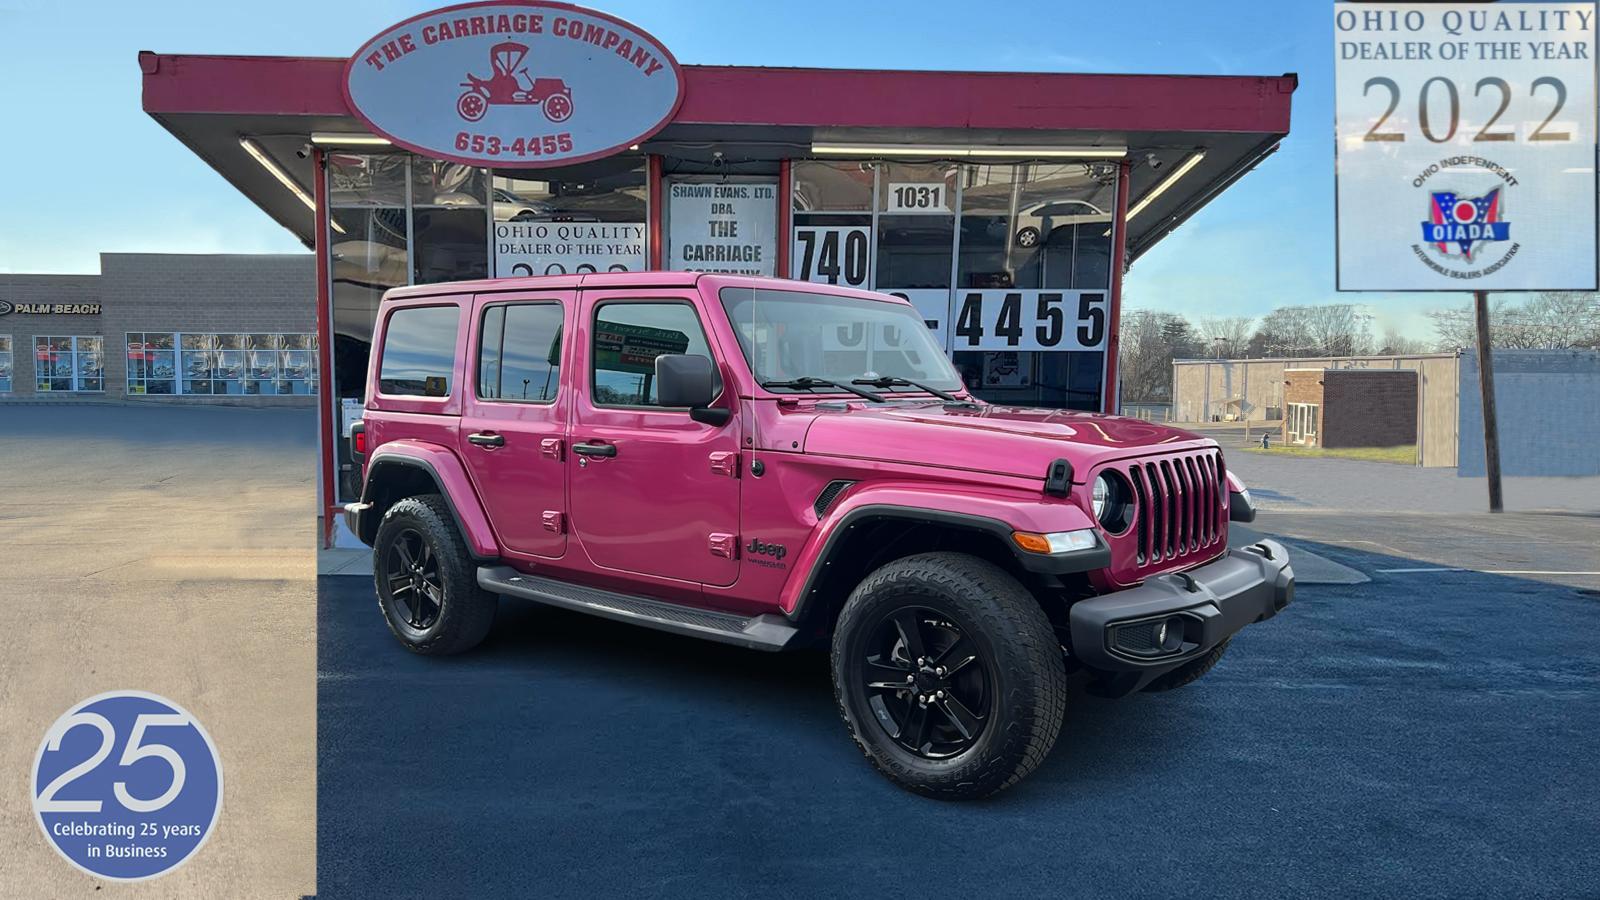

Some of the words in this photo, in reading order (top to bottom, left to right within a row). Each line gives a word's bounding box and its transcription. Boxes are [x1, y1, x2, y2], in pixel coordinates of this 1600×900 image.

[1336, 10, 1425, 31] OHIO
[1442, 10, 1592, 35] QUALITY
[365, 33, 416, 72] THE
[422, 14, 544, 45] CARRIAGE
[552, 16, 664, 77] COMPANY
[1341, 42, 1432, 60] DEALER
[1439, 42, 1469, 60] OF
[1475, 42, 1522, 60] THE
[1528, 42, 1589, 60] YEAR
[1363, 76, 1571, 143] 2022
[454, 131, 573, 156] 653-4455
[1412, 164, 1439, 188] OHIO
[1440, 155, 1519, 187] INDEPENDENT
[673, 185, 711, 198] SHAWN
[754, 187, 774, 199] LTD.
[894, 186, 941, 208] 1031
[711, 203, 736, 215] DBA.
[497, 226, 548, 238] OHIO
[557, 226, 644, 240] QUALITY
[708, 221, 738, 237] THE
[1433, 224, 1495, 240] OIADA
[500, 244, 552, 254] DEALER
[555, 244, 573, 254] OF
[577, 244, 603, 255] THE
[607, 245, 641, 255] YEAR
[683, 244, 762, 262] CARRIAGE
[797, 230, 868, 286] 740
[1410, 244, 1449, 276] AUTOMOBILE
[1450, 270, 1482, 280] DEALERS
[1483, 242, 1520, 276] ASSOCIATION
[15, 304, 51, 314] PALM
[55, 304, 100, 314] BEACH
[747, 538, 786, 560] Jeep
